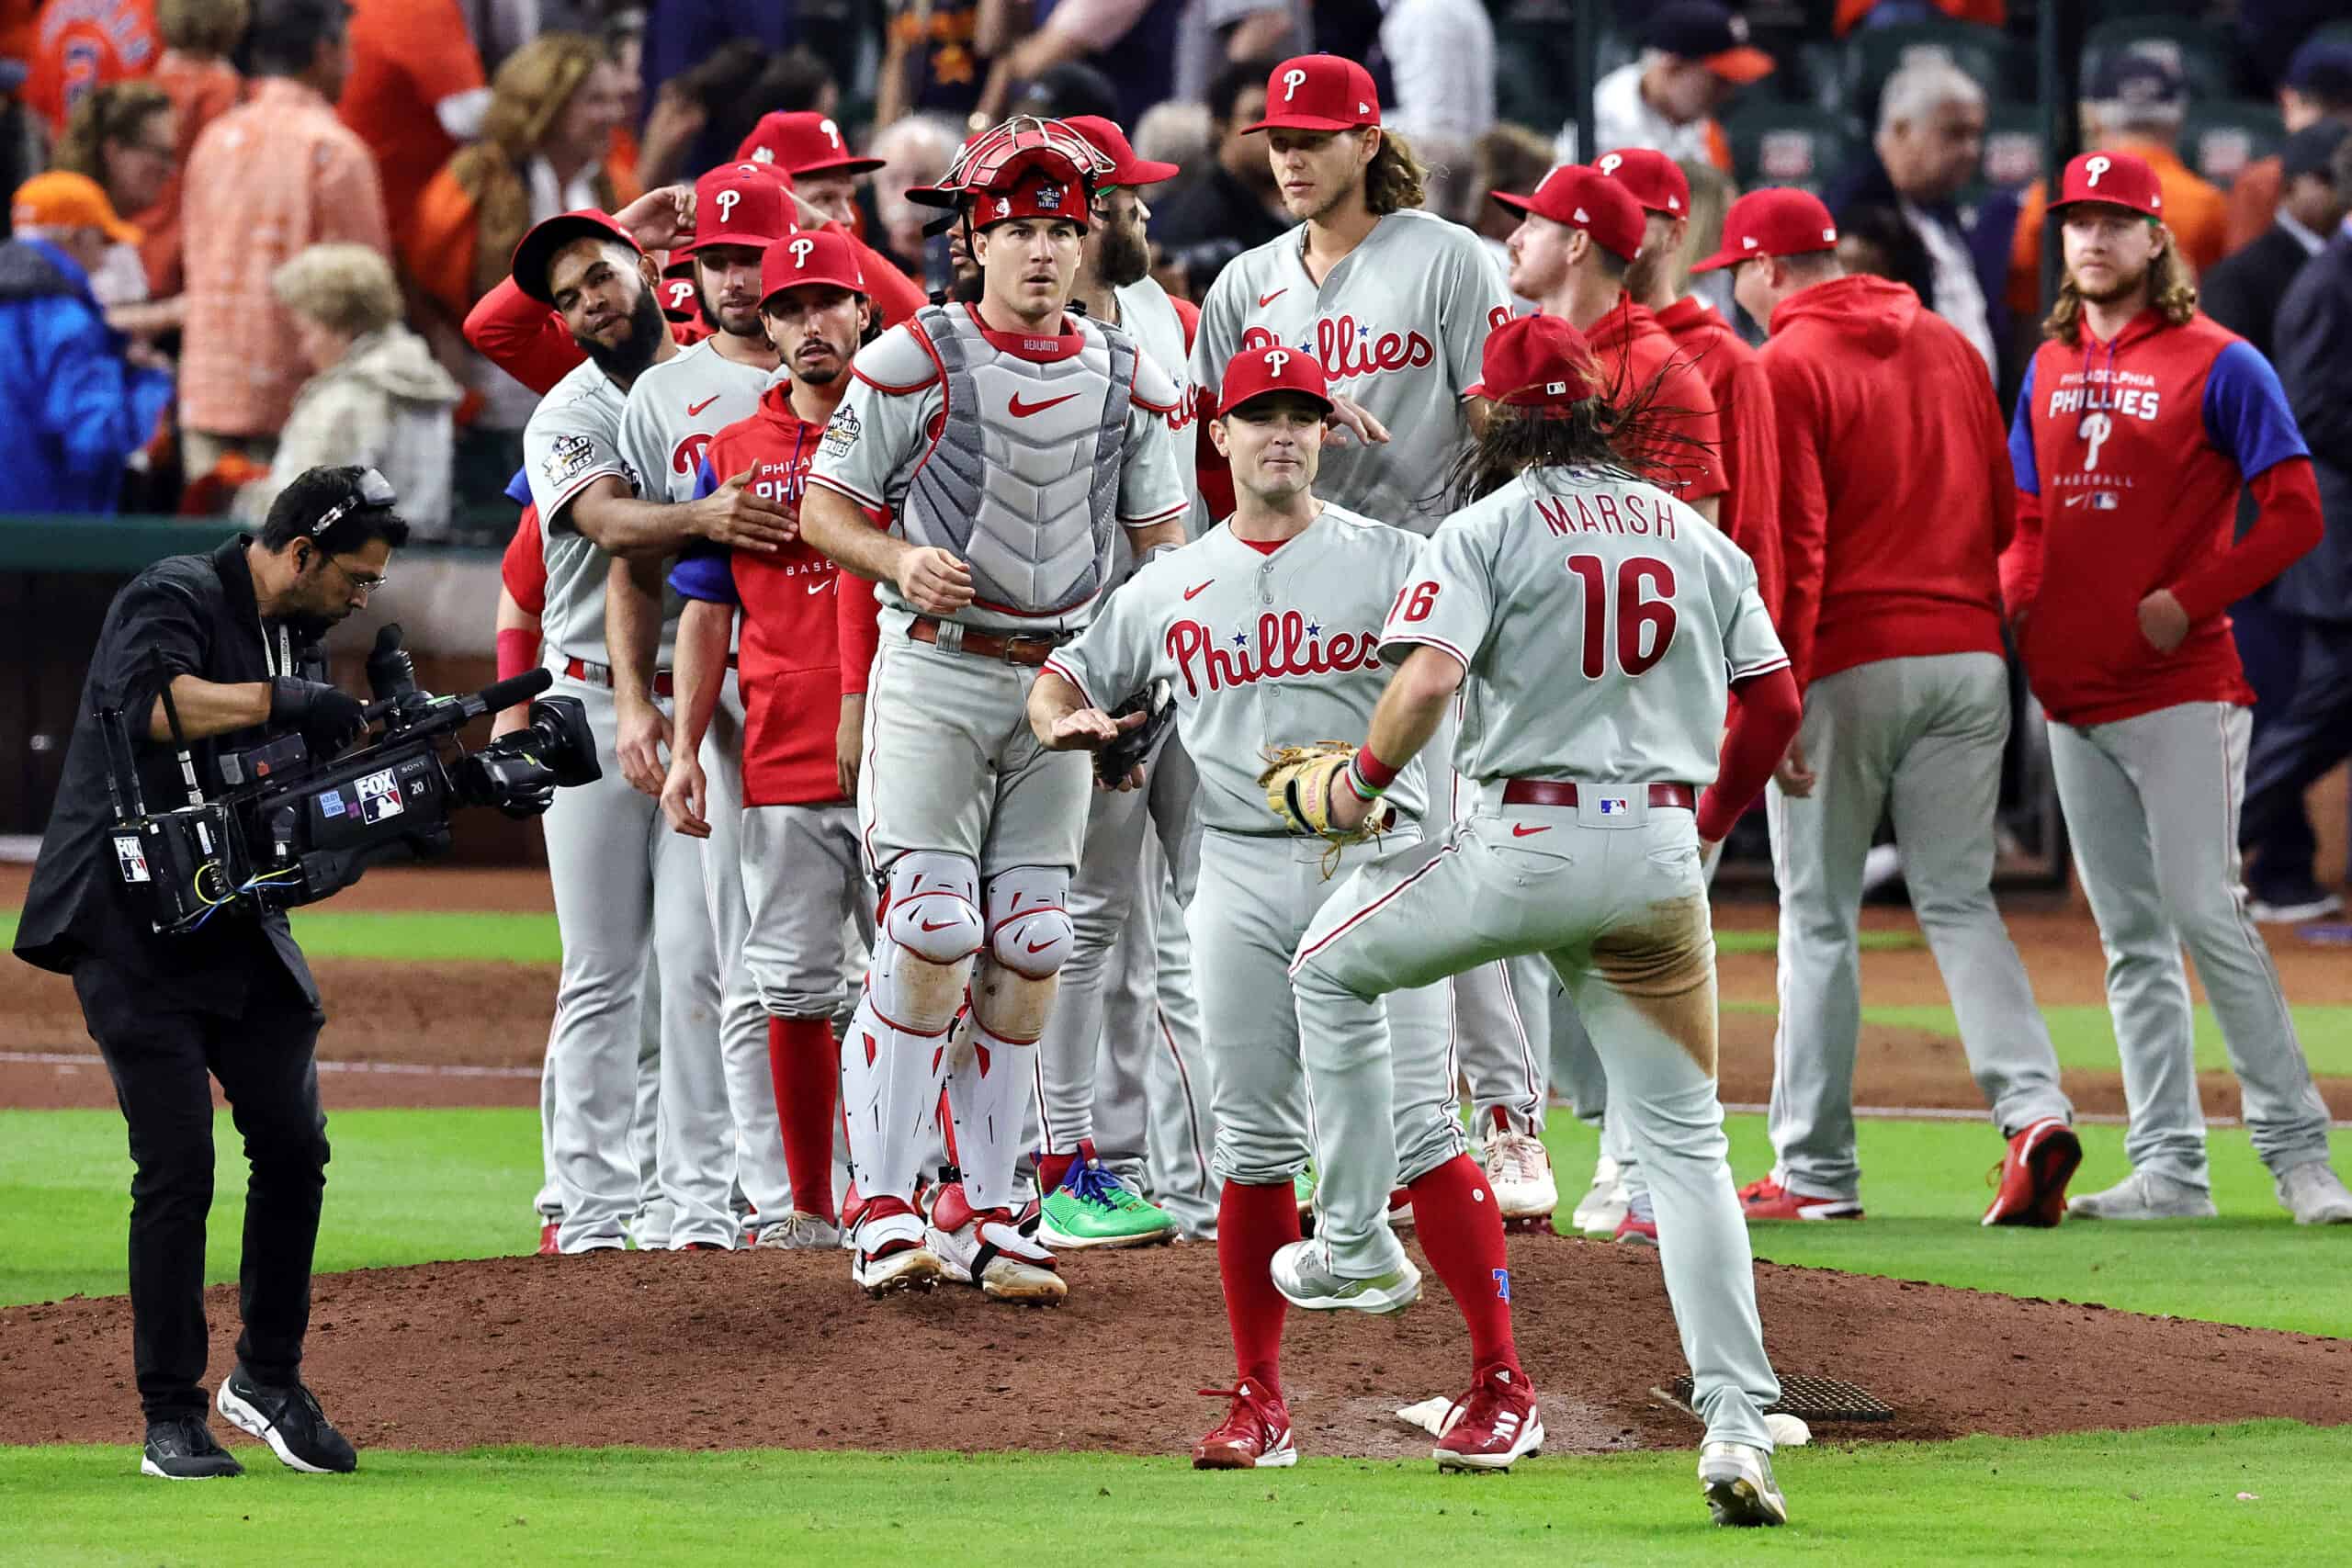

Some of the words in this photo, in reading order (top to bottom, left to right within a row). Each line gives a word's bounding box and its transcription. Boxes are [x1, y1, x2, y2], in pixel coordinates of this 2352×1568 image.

[1283, 69, 1306, 102] P
[2086, 155, 2111, 187] P
[716, 189, 741, 223] P
[1036, 189, 1060, 198] WORLD
[1038, 200, 1059, 209] SERIES
[788, 238, 814, 268] P
[668, 282, 695, 308] P
[1263, 349, 1289, 378] P
[2049, 388, 2161, 421] PHILLIES
[2079, 412, 2112, 471] P
[1534, 493, 1677, 540] MARSH
[1566, 553, 1678, 681] 16
[1166, 610, 1382, 699] Phillies
[401, 761, 426, 773] SONY
[356, 771, 397, 799] FOX
[411, 781, 424, 795] 20
[115, 838, 143, 858] FOX
